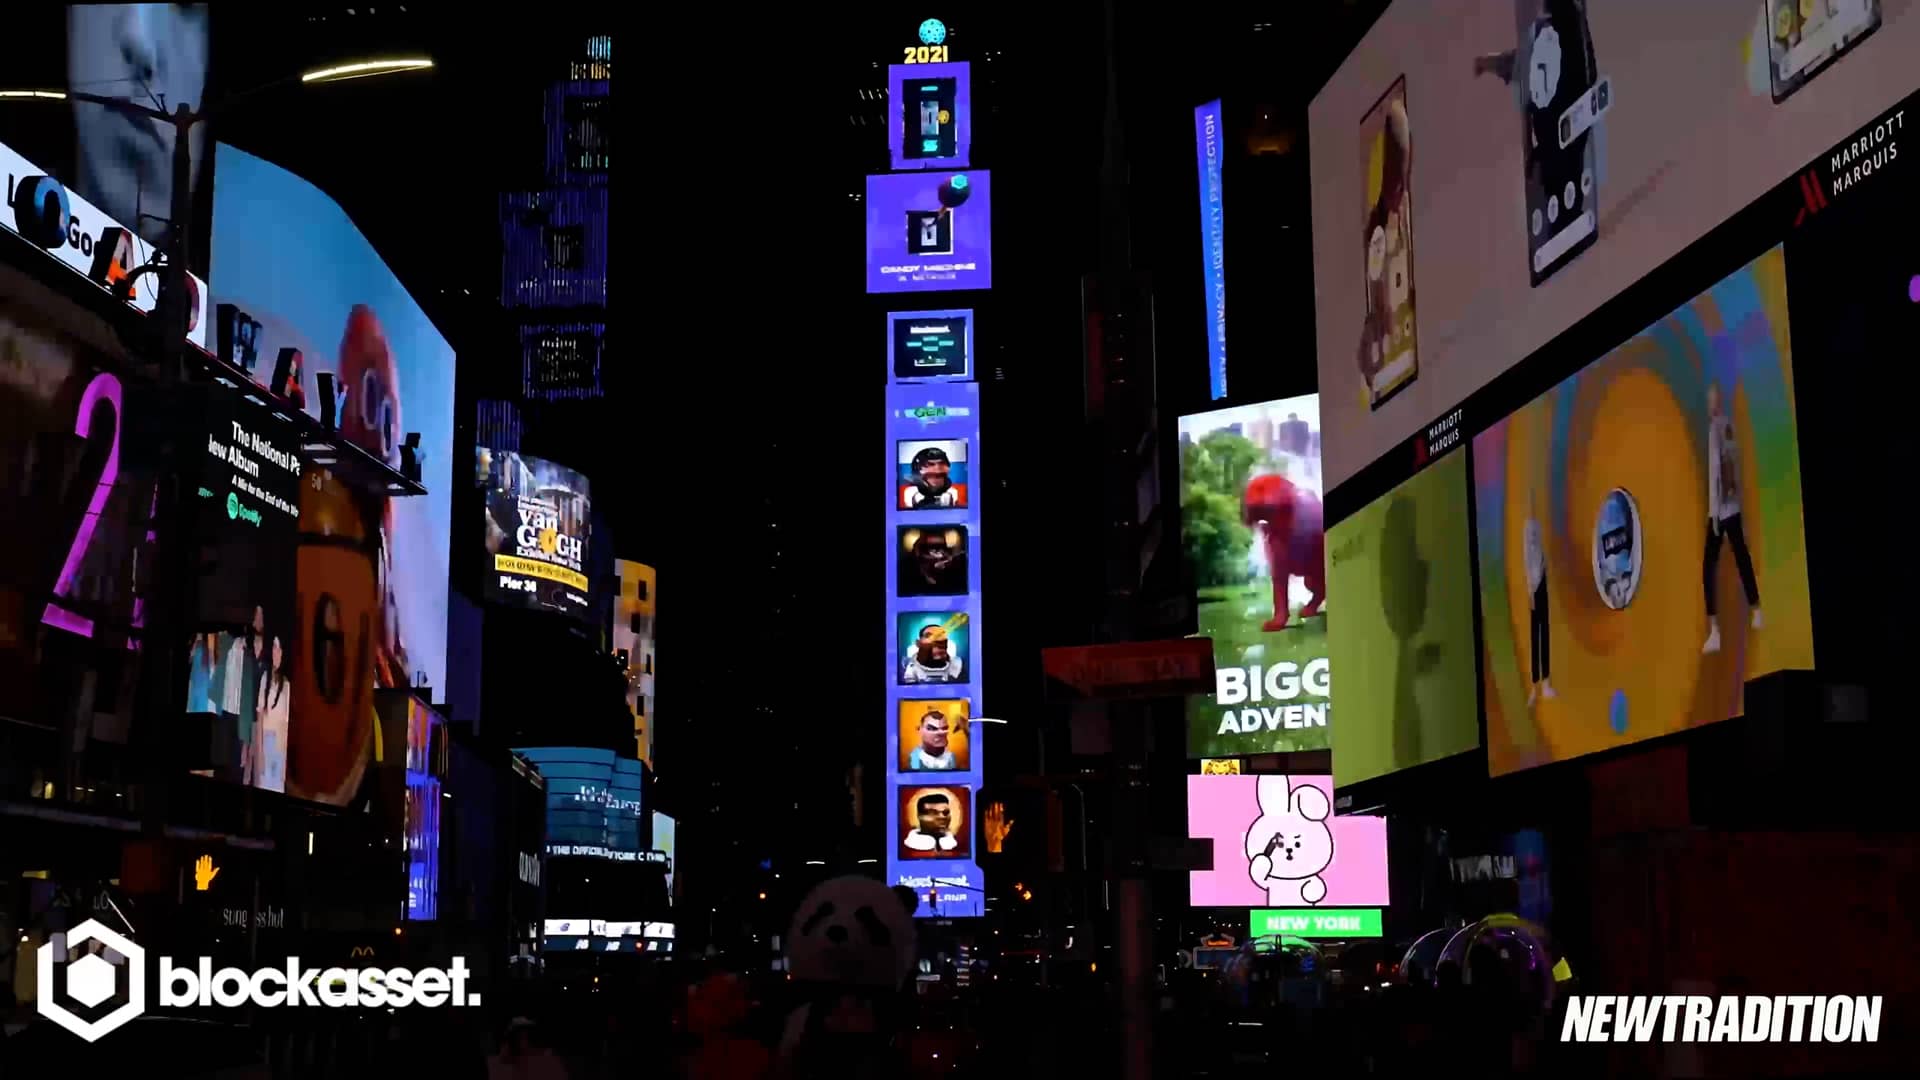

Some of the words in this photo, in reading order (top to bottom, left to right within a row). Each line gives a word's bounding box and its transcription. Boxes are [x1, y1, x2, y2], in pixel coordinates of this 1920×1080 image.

[904, 45, 949, 65] 2021
[1204, 114, 1220, 202] PROTECTION
[1831, 110, 1904, 173] MARRIOTT
[1833, 142, 1897, 197] MARQUIS
[1428, 408, 1463, 441] MARRIOTT
[232, 420, 250, 447] The
[252, 432, 289, 470] National
[1429, 428, 1460, 457] MARQUIS
[228, 445, 259, 478] Album
[231, 474, 238, 486] A
[500, 575, 523, 590] Pier
[1217, 702, 1331, 735] ADVEN
[921, 893, 968, 903] SLANA
[1266, 916, 1310, 931] NEW
[1313, 916, 1361, 931] YORK
